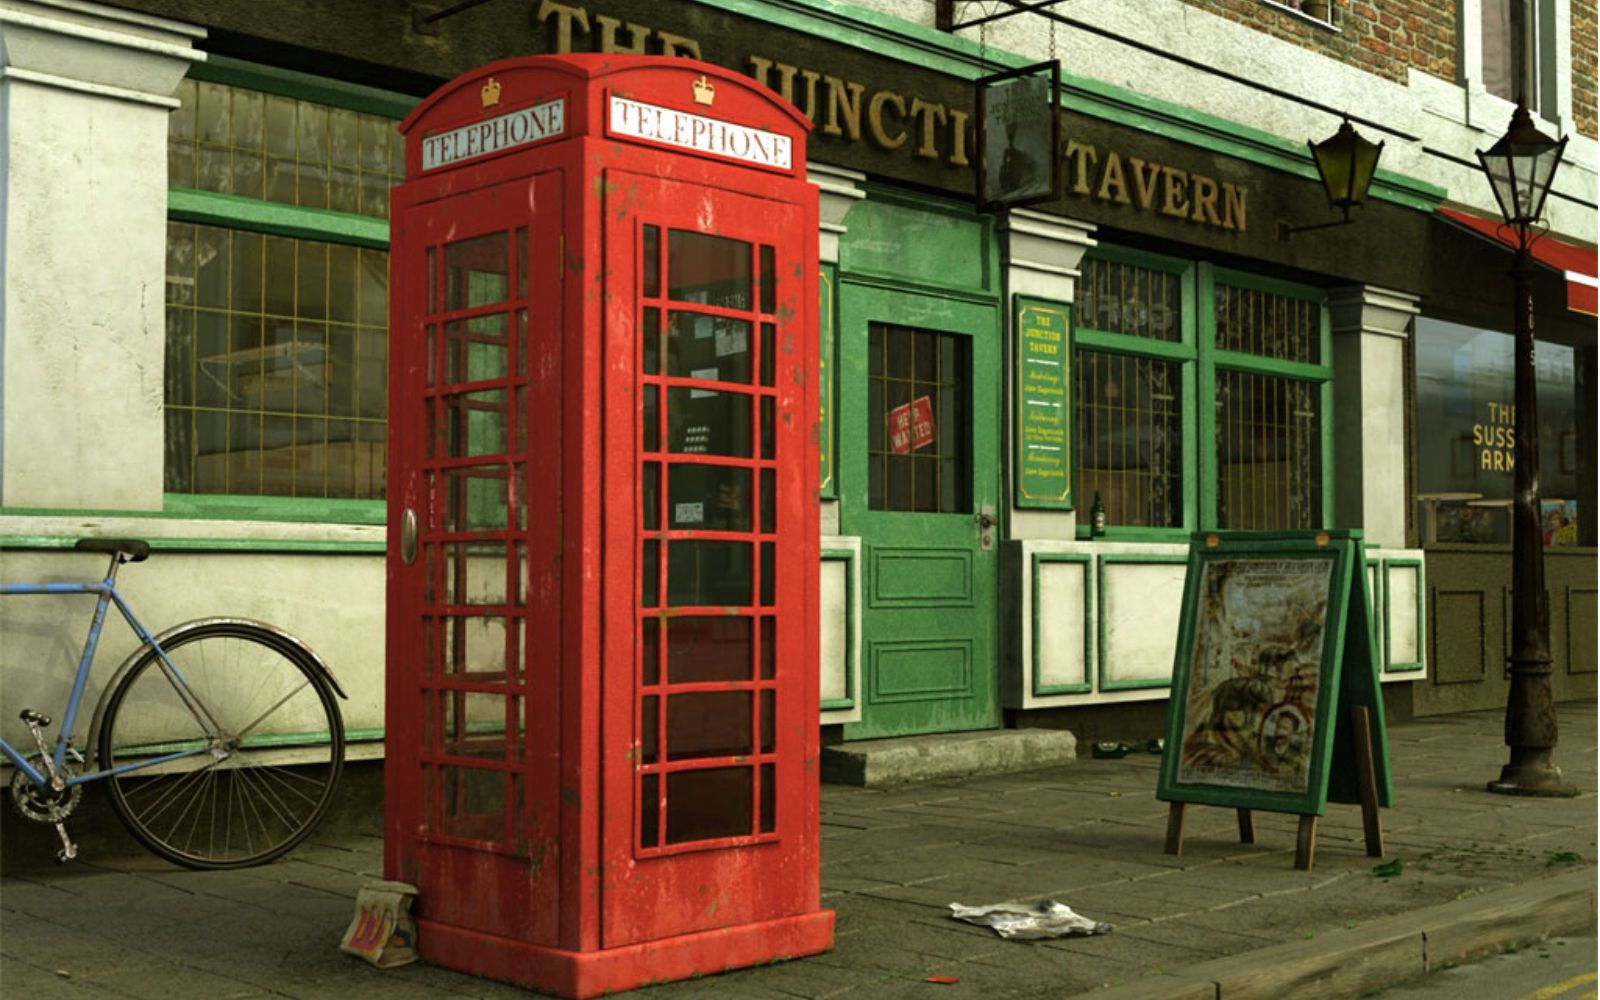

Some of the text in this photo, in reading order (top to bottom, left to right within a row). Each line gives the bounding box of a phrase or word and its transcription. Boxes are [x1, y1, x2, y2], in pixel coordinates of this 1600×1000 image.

[426, 101, 562, 167] TELEPHONE
[615, 100, 789, 167] TELEPHONE
[749, 55, 976, 167] UNCTI
[1067, 139, 1248, 232] TAVERN
[1472, 423, 1516, 449] SUSS
[1481, 448, 1516, 472] ARM
